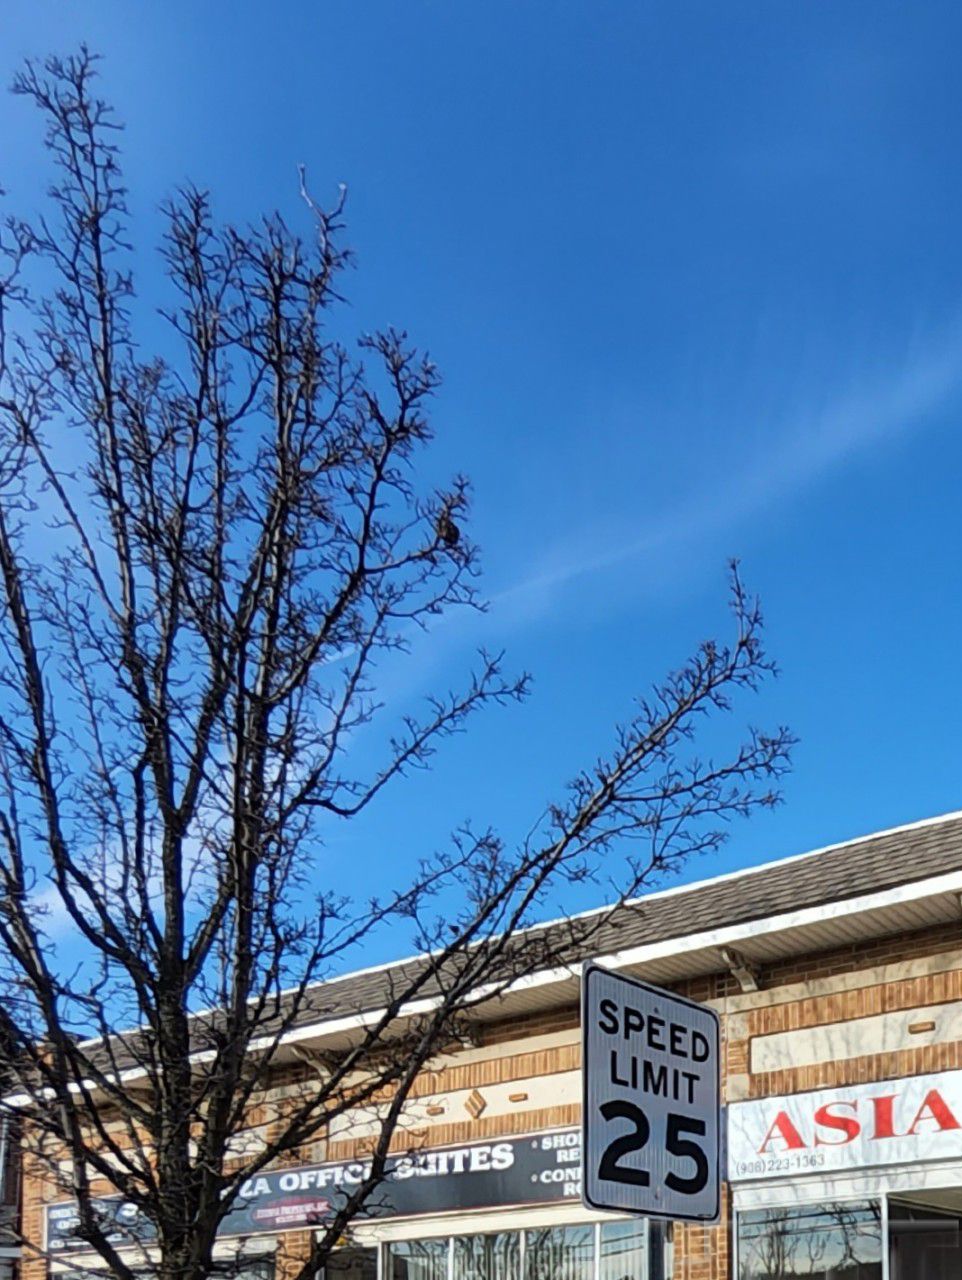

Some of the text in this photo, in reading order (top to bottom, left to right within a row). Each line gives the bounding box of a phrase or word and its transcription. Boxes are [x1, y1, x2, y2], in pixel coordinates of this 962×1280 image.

[599, 999, 709, 1063] SPEED
[611, 1050, 700, 1104] LIMIT
[393, 1143, 515, 1180] SUITES
[541, 1132, 582, 1151] SHO
[598, 1100, 709, 1195] 25
